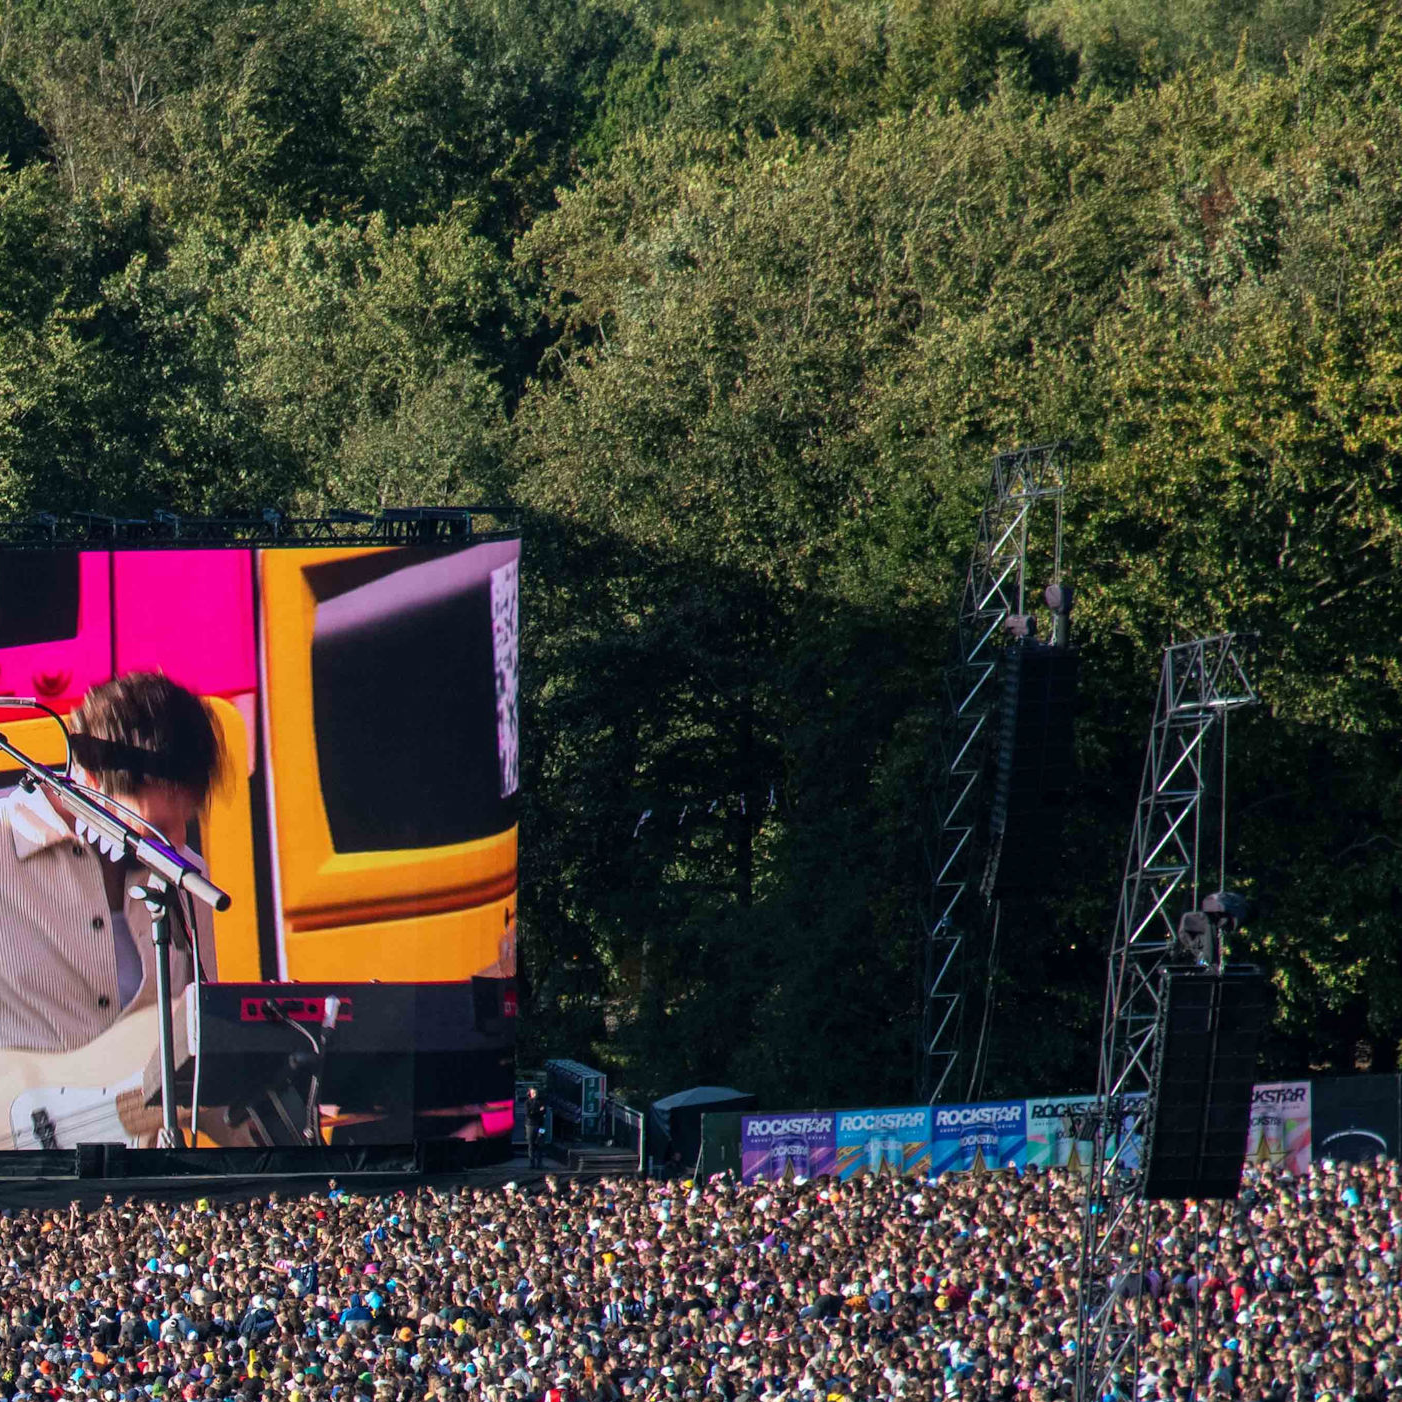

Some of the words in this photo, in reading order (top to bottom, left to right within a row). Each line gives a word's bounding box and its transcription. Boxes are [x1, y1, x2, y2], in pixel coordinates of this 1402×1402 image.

[840, 1112, 925, 1131] ROCKSTAR
[936, 1105, 1022, 1126] ROCKSTAR
[747, 1117, 832, 1136] ROCKSTAR
